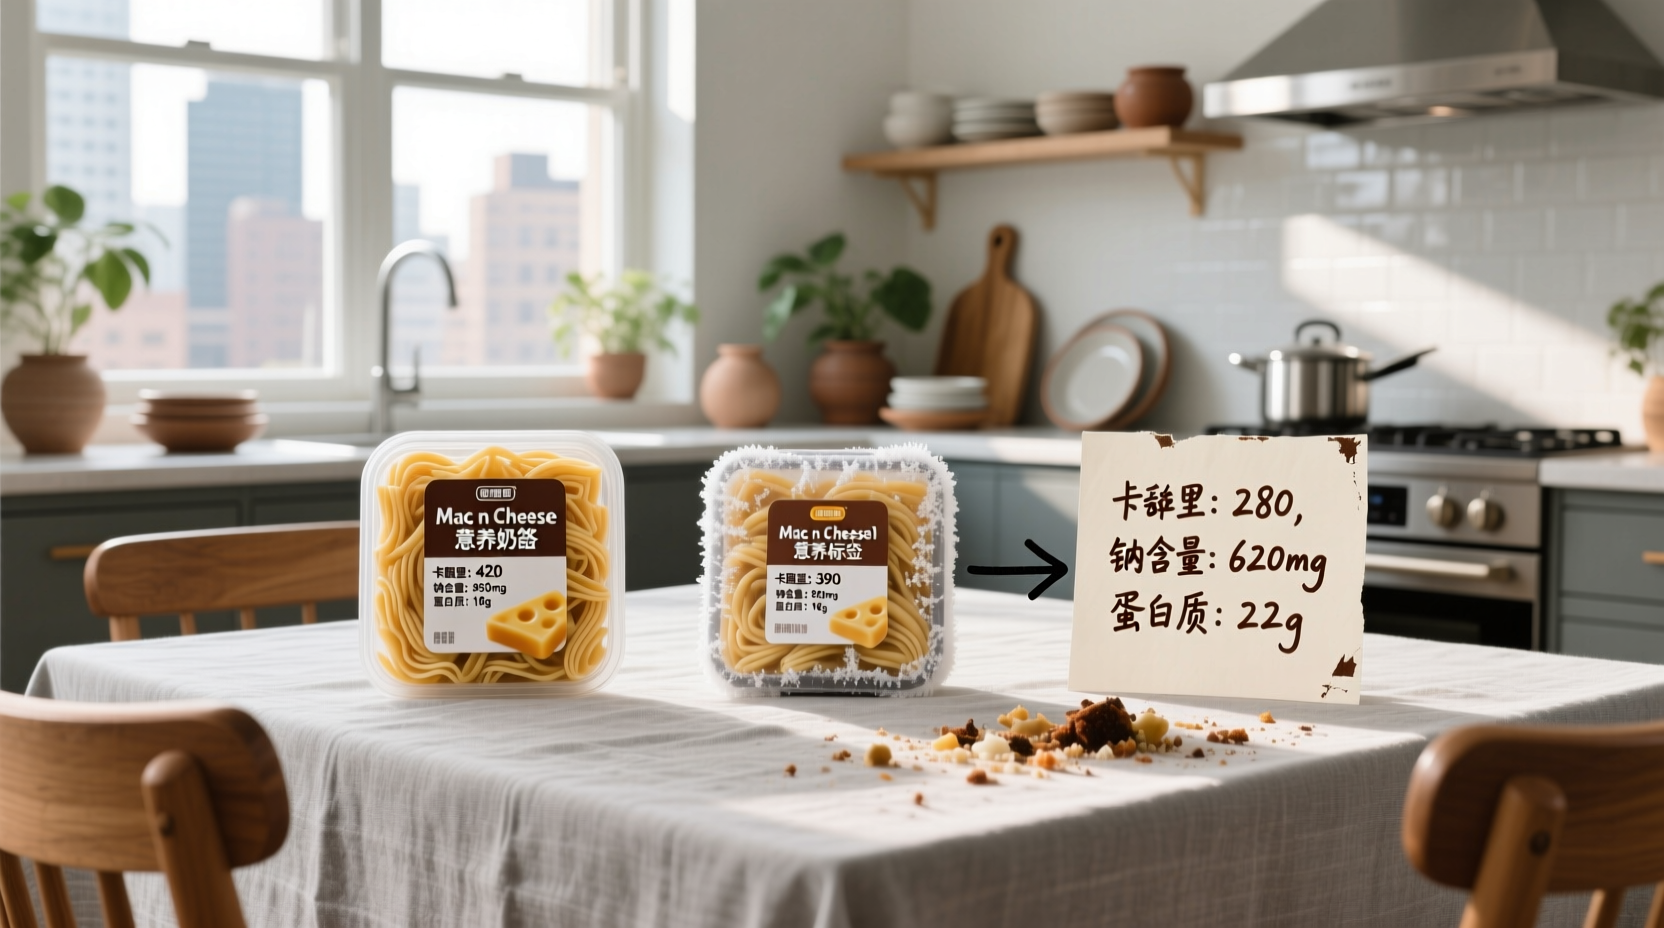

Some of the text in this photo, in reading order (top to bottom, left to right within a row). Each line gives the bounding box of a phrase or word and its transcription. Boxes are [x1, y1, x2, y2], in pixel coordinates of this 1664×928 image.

[436, 506, 557, 525] Mac n Cheese
[1232, 485, 1303, 527] 280,
[779, 525, 809, 540] Mac
[812, 530, 820, 540] n
[475, 564, 503, 578] 420
[1229, 539, 1327, 593] 620mg
[815, 572, 841, 585] 390
[1237, 601, 1303, 654] 22g
